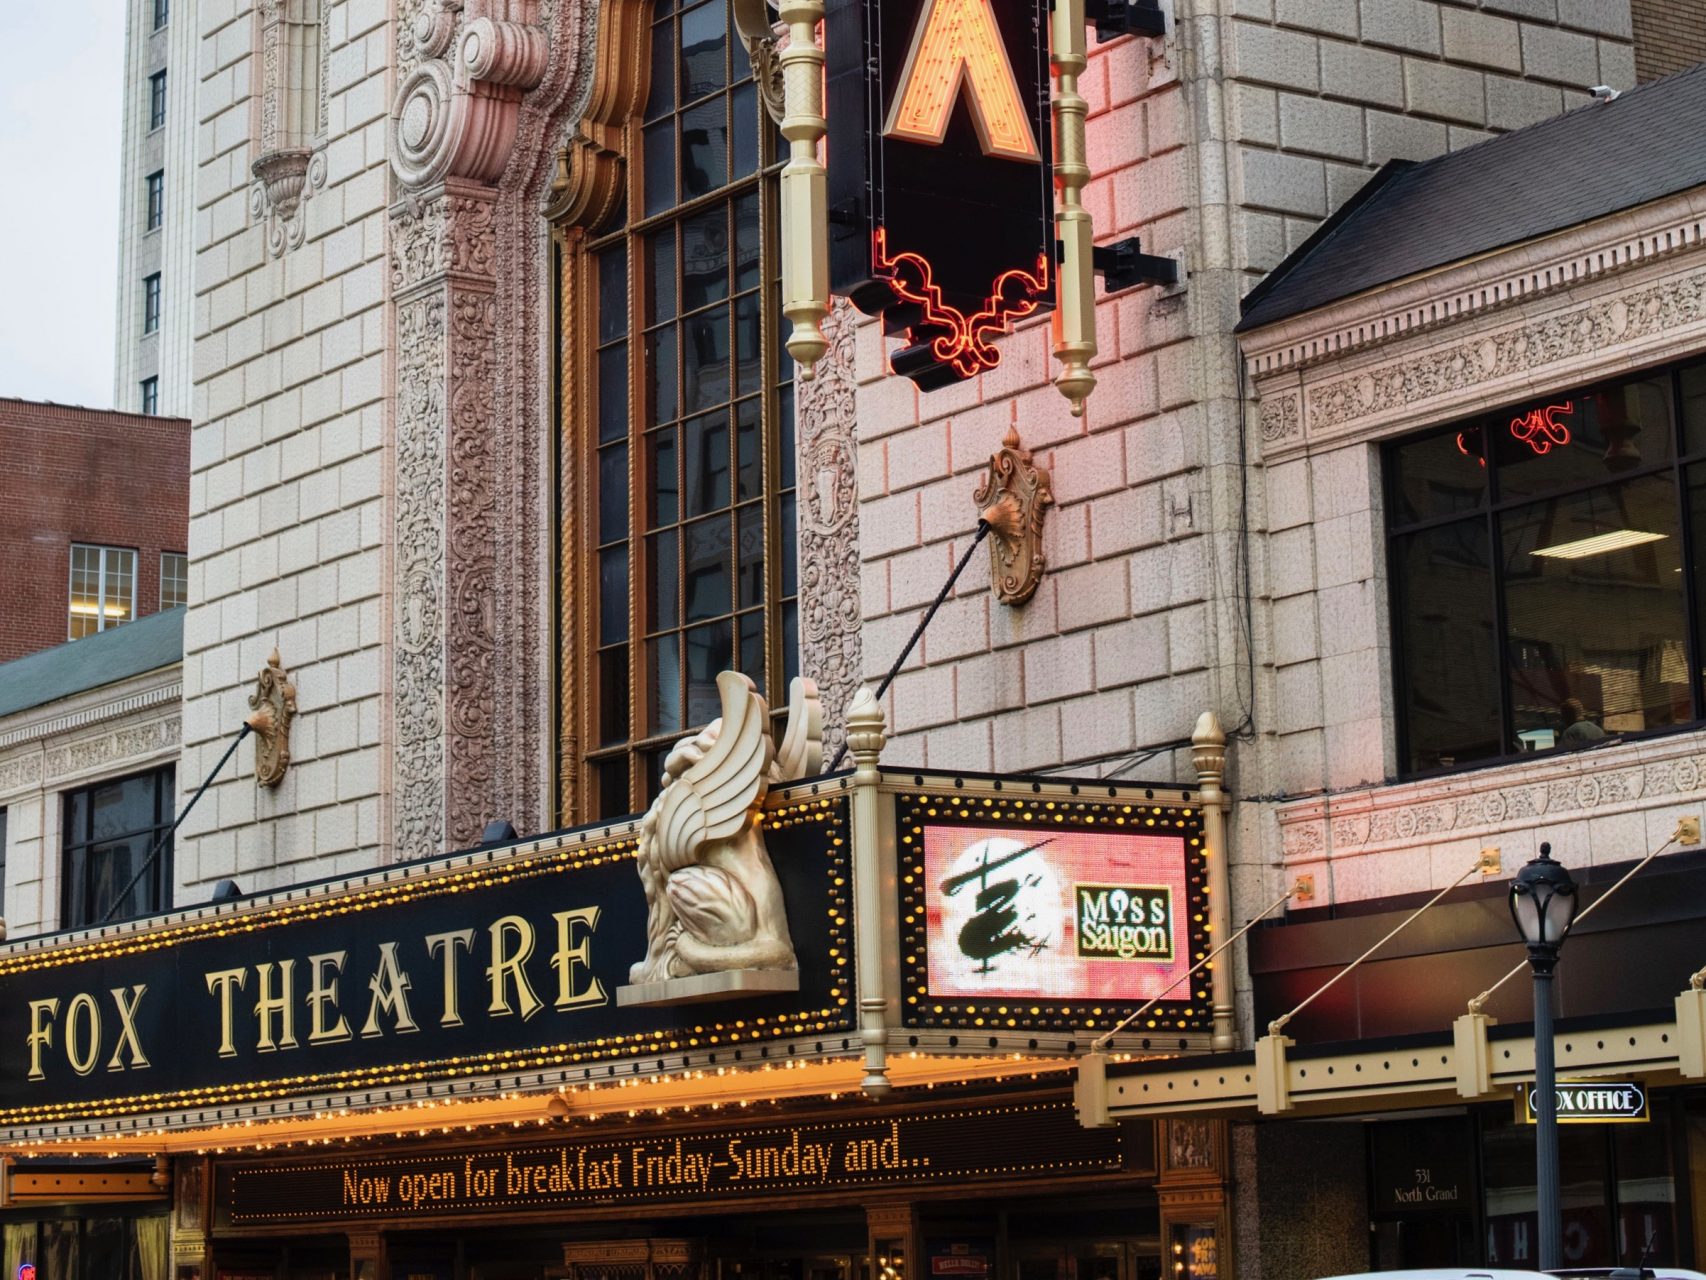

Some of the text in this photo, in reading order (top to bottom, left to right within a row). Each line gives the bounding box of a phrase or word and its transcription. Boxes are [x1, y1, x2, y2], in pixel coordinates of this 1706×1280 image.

[1081, 920, 1169, 959] Saigon
[27, 905, 609, 1081] FOX THEATRE
[1576, 1090, 1634, 1111] OFFICE
[344, 1170, 390, 1205] Now
[399, 1172, 455, 1210] open
[465, 1157, 499, 1197] for
[507, 1149, 622, 1195] breakfast
[844, 1123, 930, 1171] and...
[1394, 1184, 1458, 1202] North Grand
